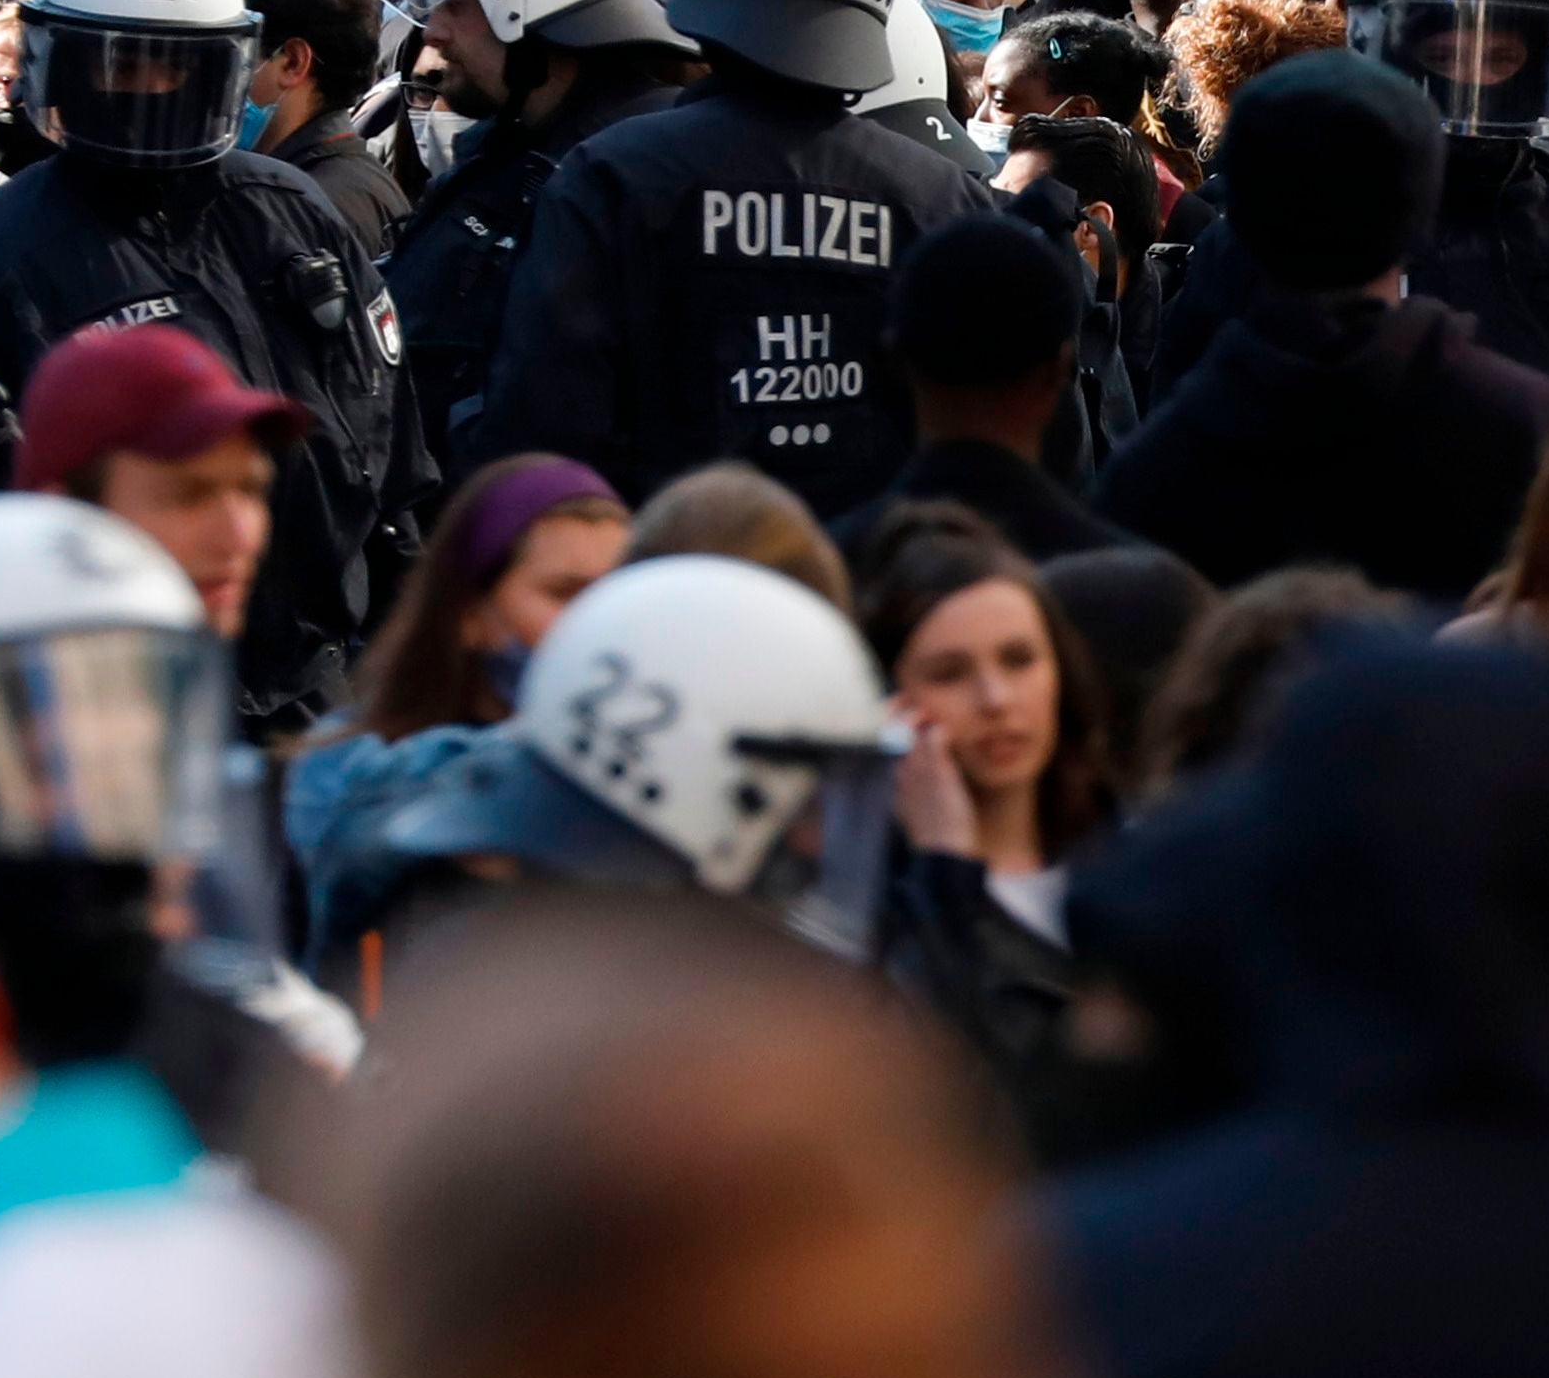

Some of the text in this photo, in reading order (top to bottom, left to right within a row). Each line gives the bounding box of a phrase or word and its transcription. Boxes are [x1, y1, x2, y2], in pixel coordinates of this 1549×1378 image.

[925, 116, 955, 142] 2
[702, 189, 893, 269] POLIZEI
[757, 313, 831, 363] HH
[729, 362, 863, 405] 122000
[562, 651, 682, 767] 22
